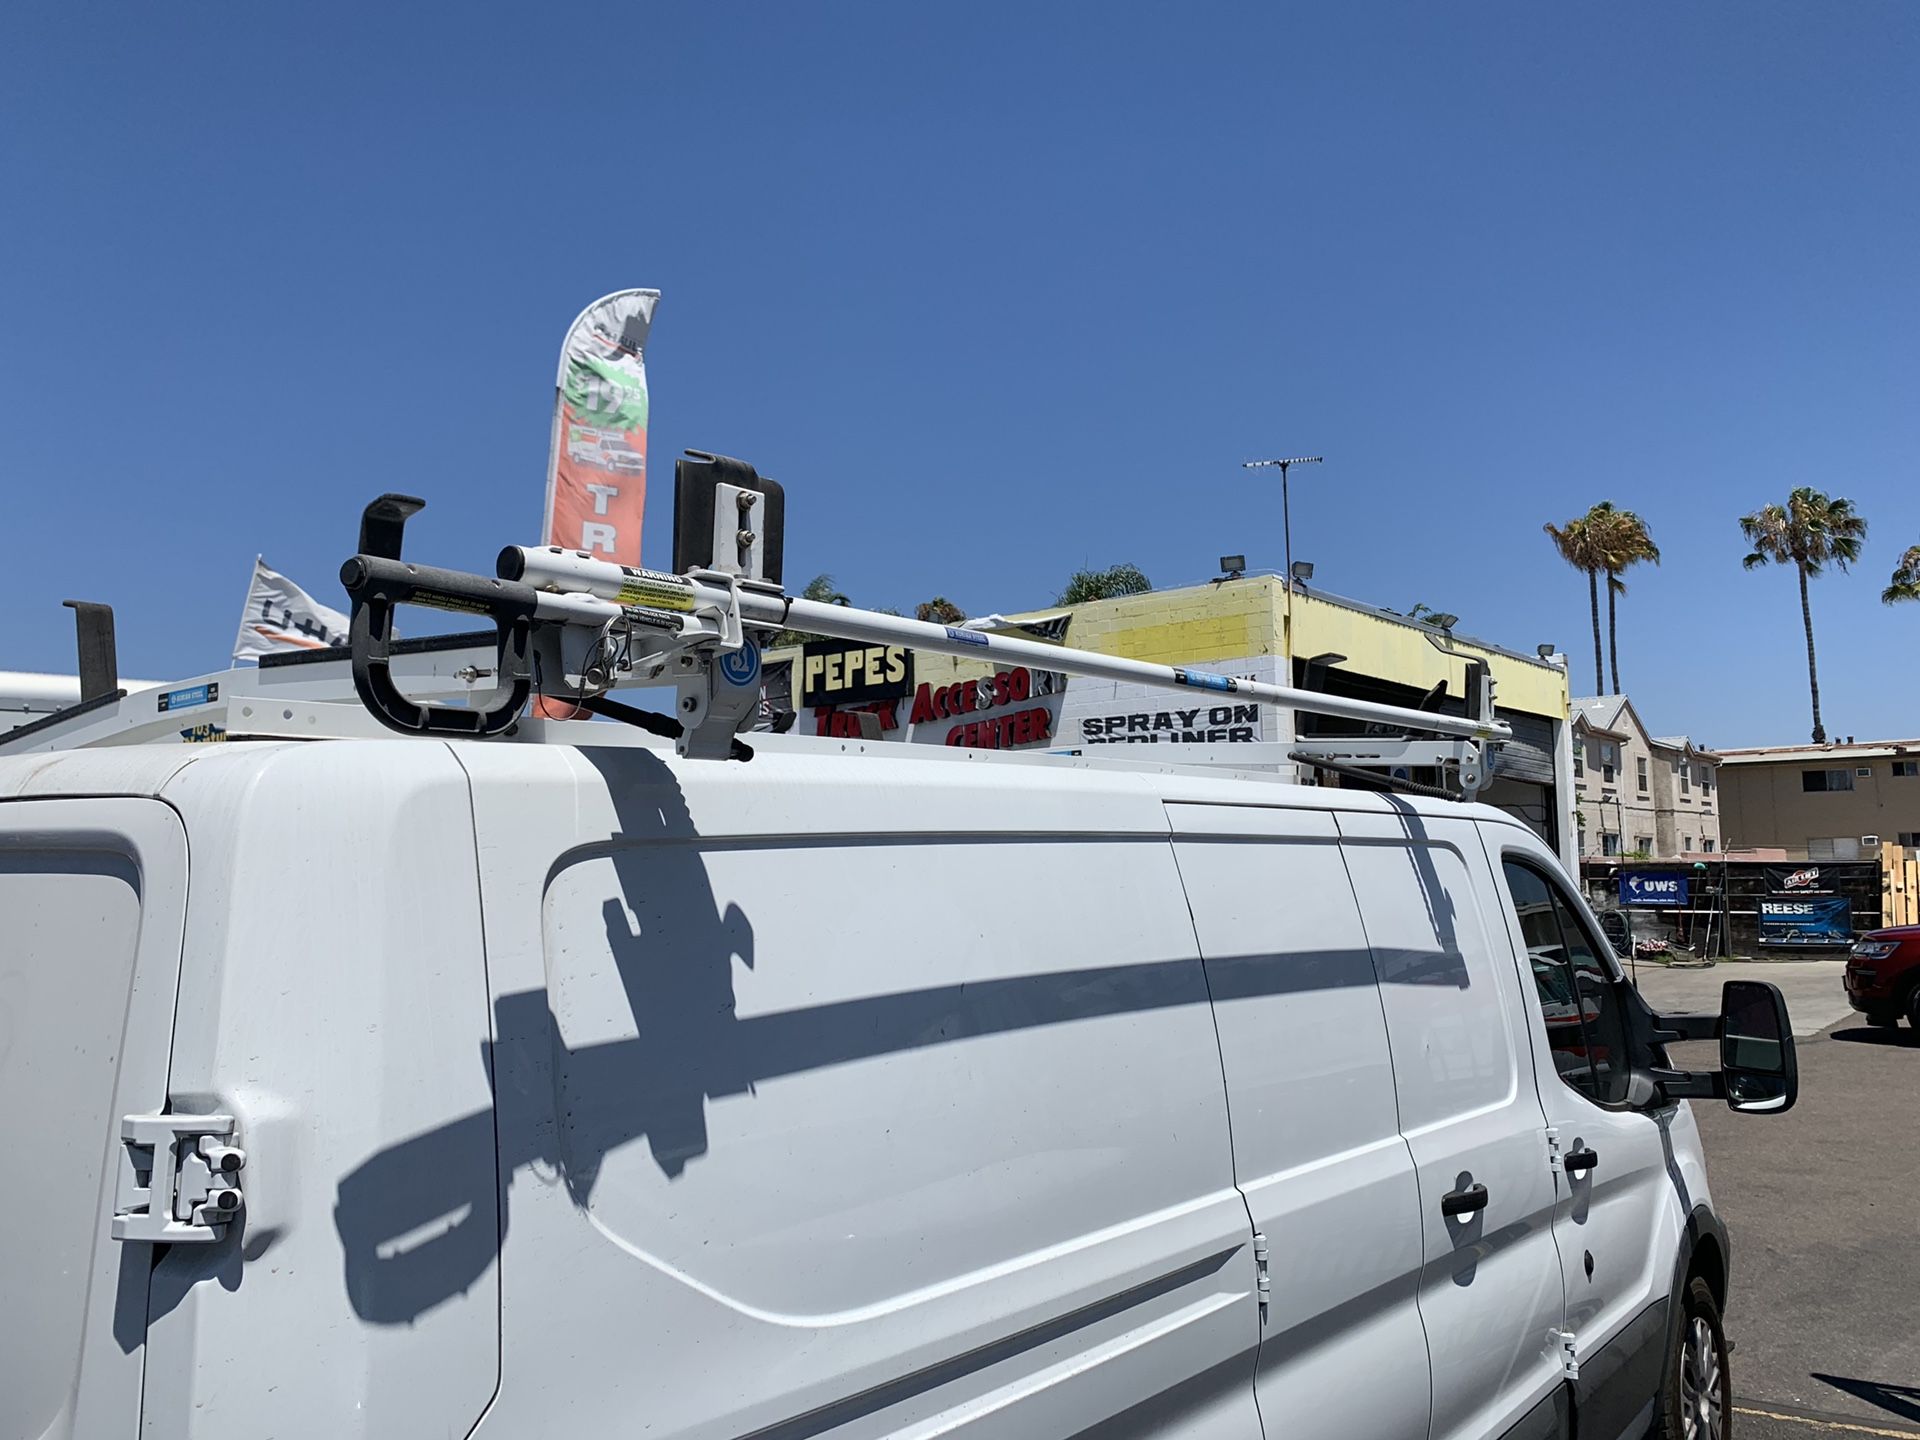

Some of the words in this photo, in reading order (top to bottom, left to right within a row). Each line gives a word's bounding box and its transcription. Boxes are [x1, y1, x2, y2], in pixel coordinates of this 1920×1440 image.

[629, 568, 684, 583] WARNING
[805, 645, 905, 693] PEPES
[815, 699, 898, 738] TRUK
[910, 666, 1067, 724] ACCESSORY
[945, 706, 1052, 749] CENTER
[1083, 708, 1200, 735] SPRAY
[1208, 703, 1258, 726] ON
[1087, 726, 1253, 744] LINER
[1644, 880, 1678, 892] UWS
[1761, 903, 1814, 915] REESE
